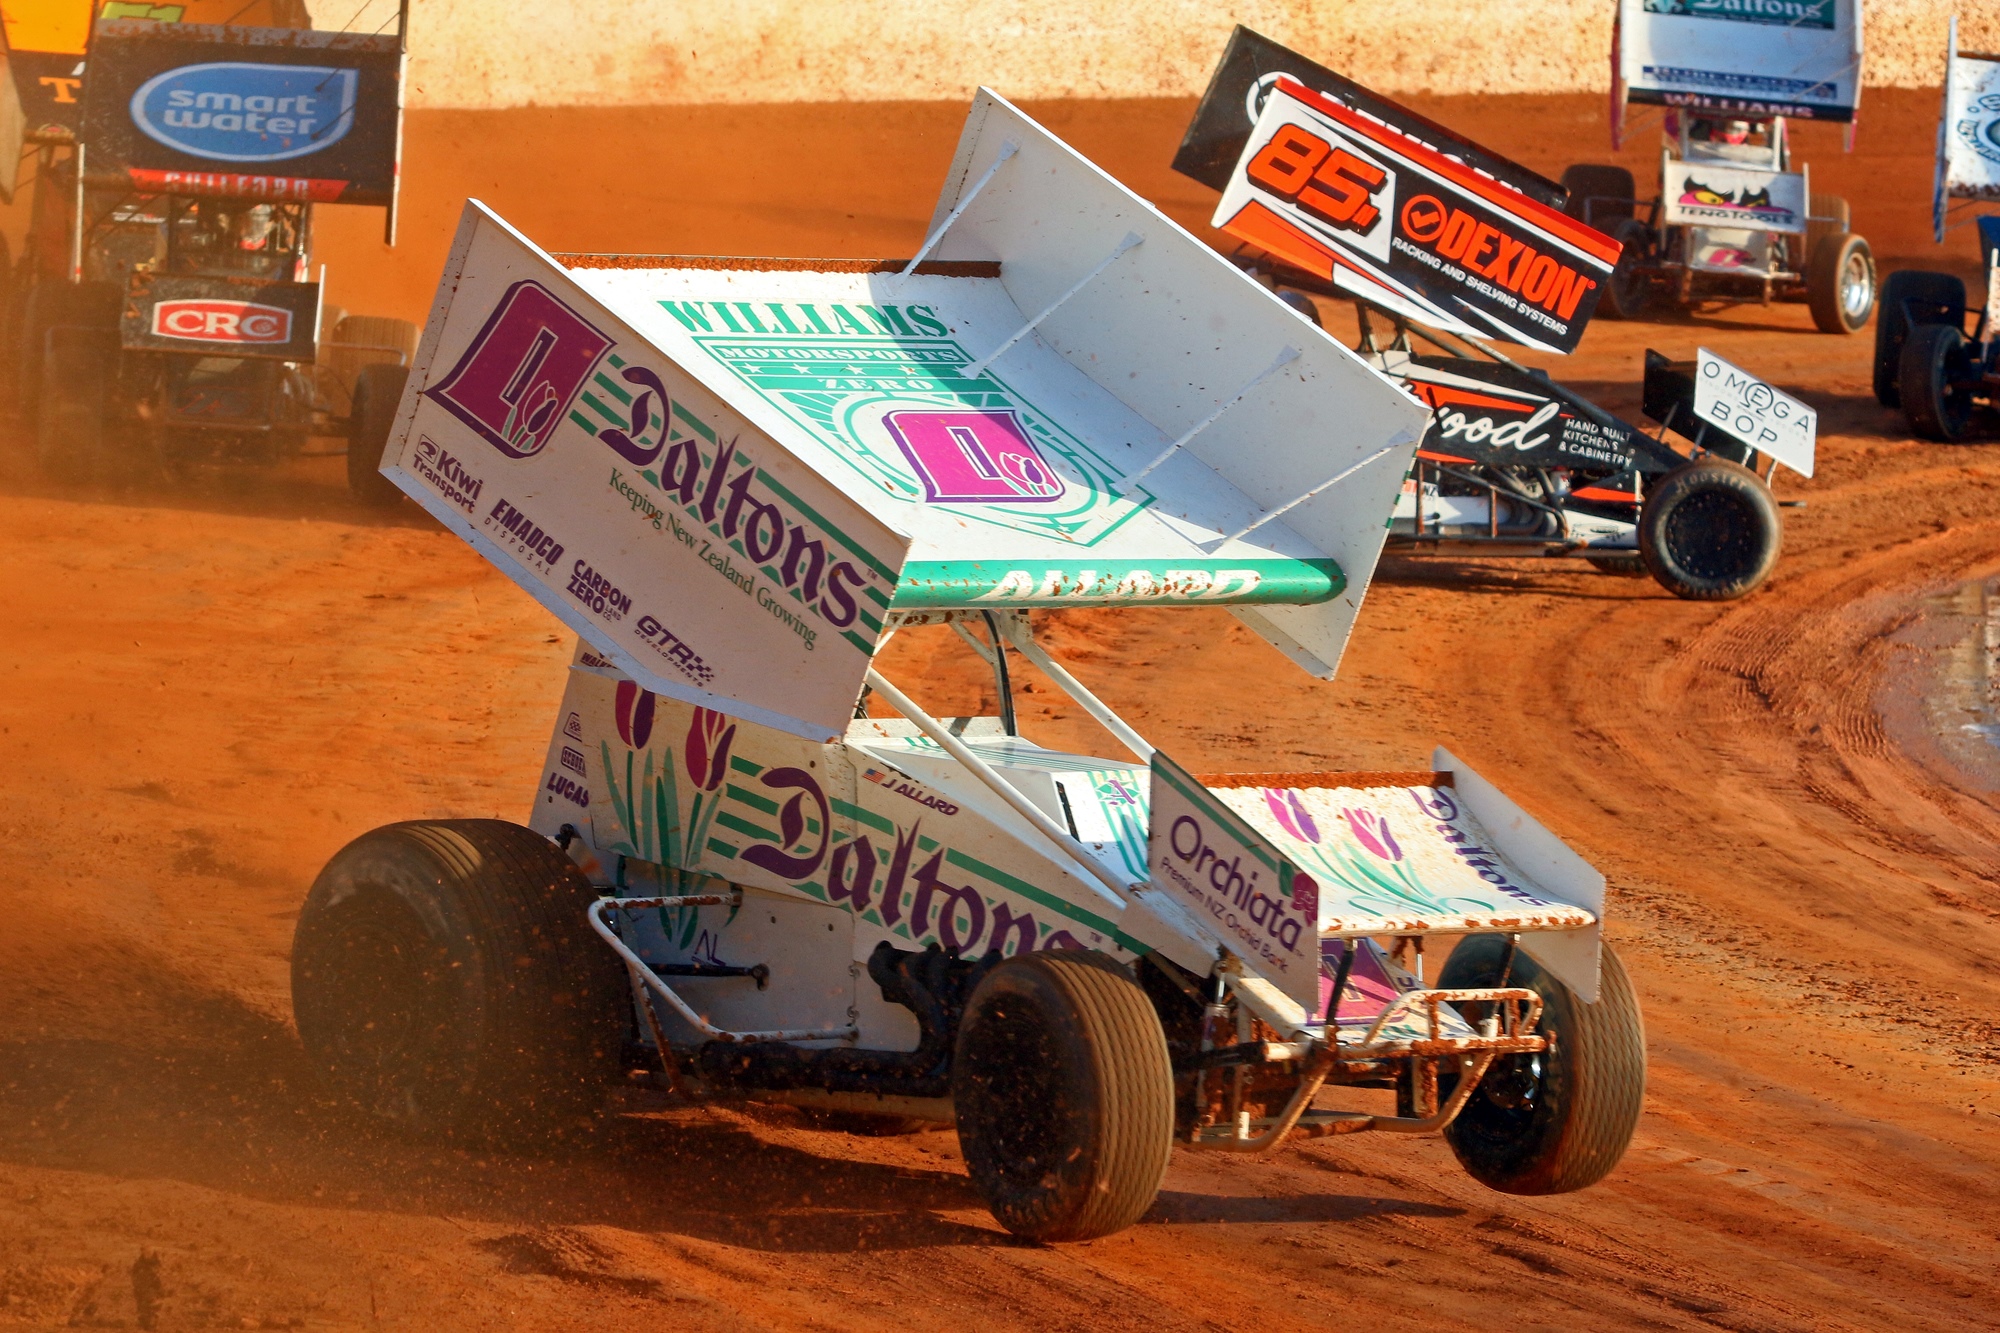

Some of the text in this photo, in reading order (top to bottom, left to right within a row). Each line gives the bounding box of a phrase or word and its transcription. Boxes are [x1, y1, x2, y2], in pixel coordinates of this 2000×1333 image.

[1692, 0, 1823, 19] altons
[163, 109, 318, 136] water
[168, 89, 316, 116] smart
[1663, 93, 1815, 118] WILLIAMS
[1392, 236, 1569, 337] RACKING AND SHELVING SYSTEMS
[1435, 208, 1590, 322] DEXION
[164, 308, 279, 339] CRC
[655, 300, 950, 340] WILLIAMS
[715, 345, 964, 363] MOTORSPORTS
[816, 377, 935, 391] ZERO
[1702, 360, 1811, 435] OMEGA
[1562, 430, 1620, 451] KITCHENS
[1564, 418, 1633, 442] HAND BUILT
[1710, 399, 1779, 444] BOP
[436, 449, 484, 501] Kiwi
[1558, 442, 1633, 468] & CABINETRY
[412, 453, 476, 515] Transport
[598, 366, 867, 628] Daltons
[483, 517, 551, 577] DISPOSAL
[489, 498, 565, 566] EMADCO
[608, 467, 820, 652] Keeping New Zealand Growing
[565, 574, 622, 622] ZERO LAND
[573, 559, 633, 616] CARBON
[634, 628, 705, 688] DEVELOPMENTS
[546, 772, 590, 808] LUCAS
[880, 776, 960, 817] J ALLARD
[1406, 787, 1555, 909] Daltons
[1170, 815, 1304, 953] Orchiata
[1159, 856, 1289, 975] Premium NZ Orchid Bank
